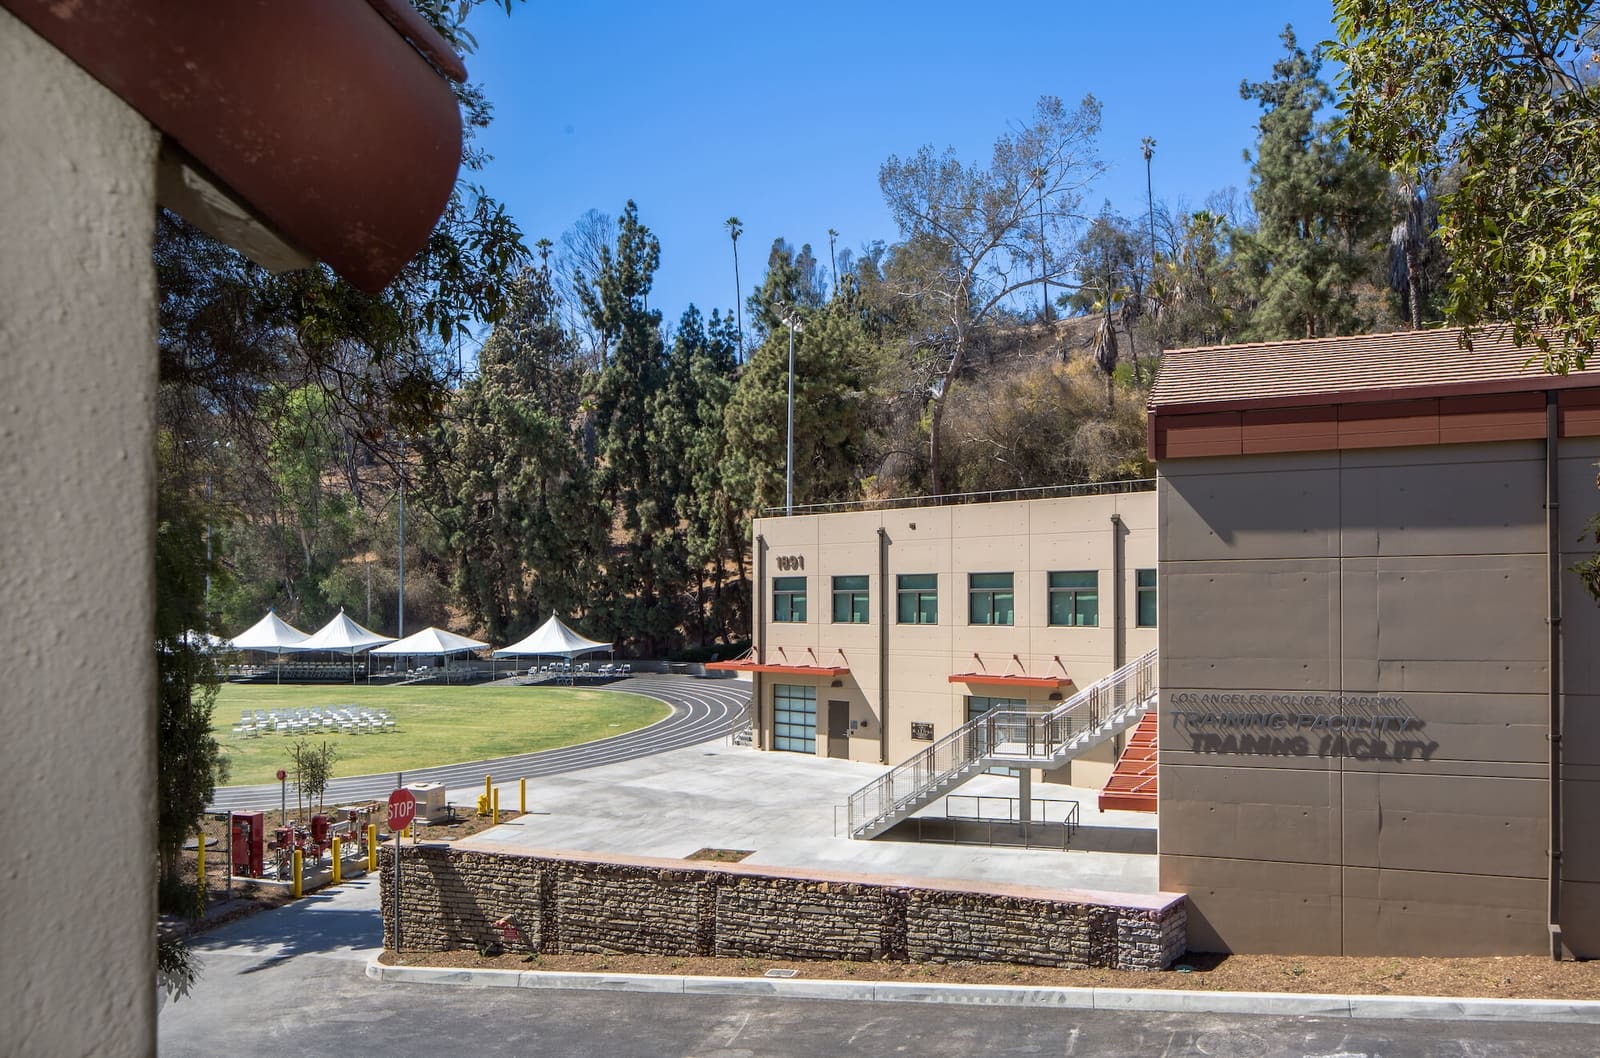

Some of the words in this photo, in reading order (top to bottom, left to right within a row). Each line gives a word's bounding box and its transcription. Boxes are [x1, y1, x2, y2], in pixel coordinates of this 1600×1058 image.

[1170, 693, 1198, 704] LOS
[1201, 693, 1268, 705] ANGELES
[1271, 695, 1325, 706] POLICE
[1328, 695, 1403, 707] ACADEMY
[1170, 711, 1286, 731] TRAINING
[1296, 714, 1415, 734] FACILITY
[388, 801, 414, 819] STOP
